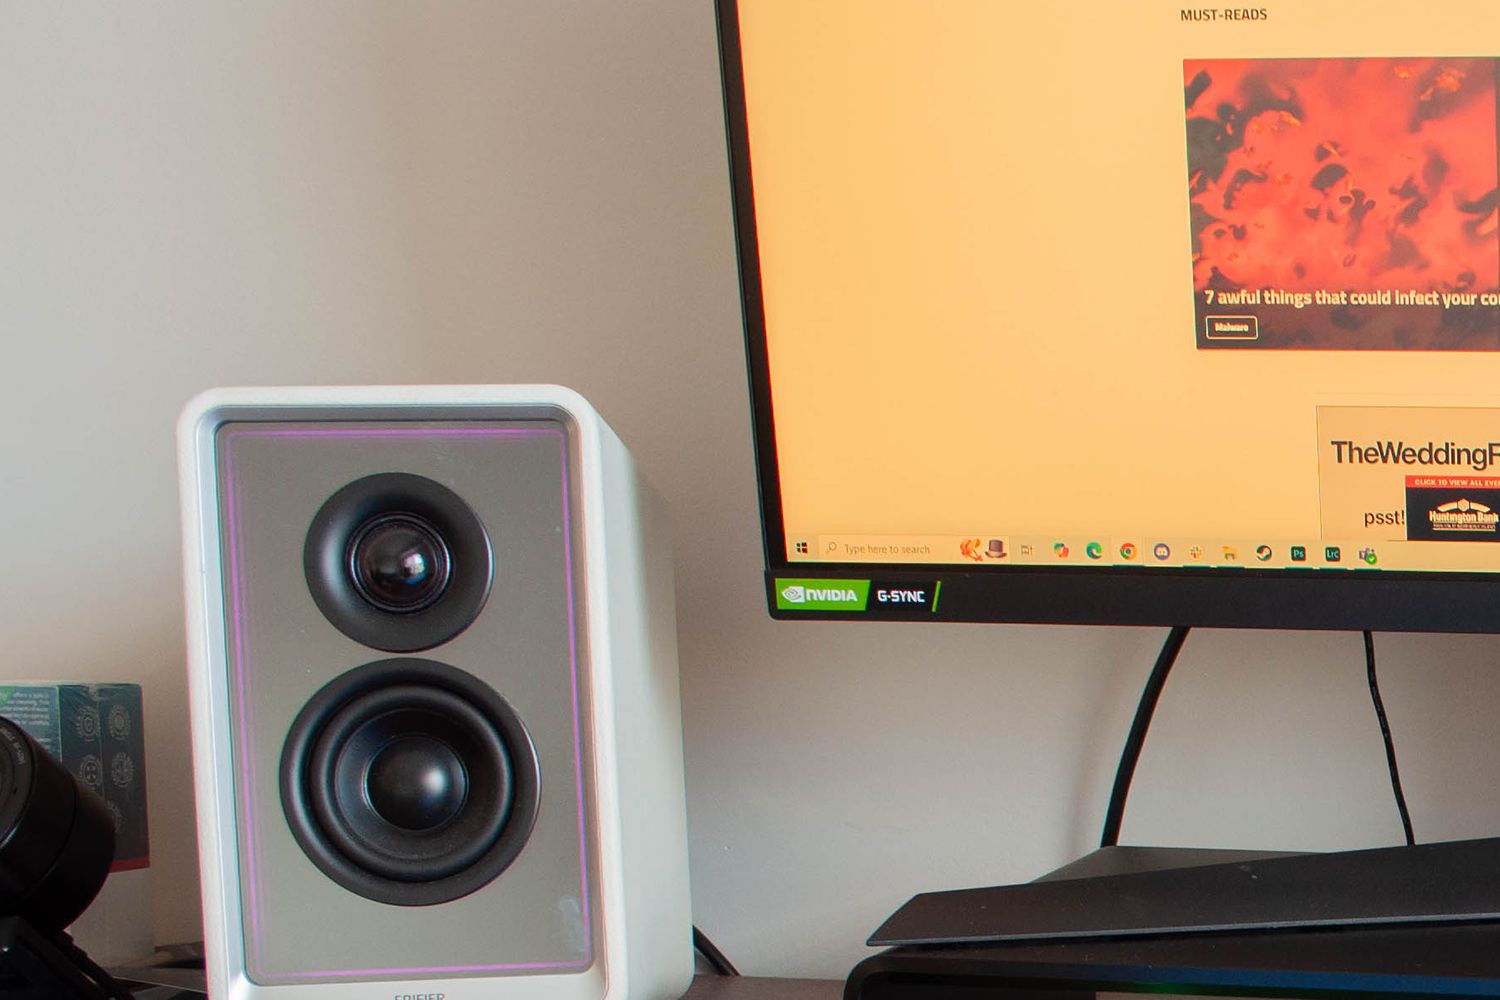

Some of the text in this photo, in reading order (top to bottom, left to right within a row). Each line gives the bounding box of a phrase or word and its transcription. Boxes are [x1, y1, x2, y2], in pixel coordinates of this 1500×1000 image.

[1180, 9, 1267, 21] MUST-READS
[1205, 290, 1214, 304] 7
[1217, 290, 1260, 306] awful
[1263, 290, 1312, 308] things
[1315, 291, 1348, 306] that
[1351, 290, 1392, 306] could
[1395, 290, 1440, 306] infect
[1443, 293, 1477, 309] your
[1214, 322, 1249, 333] Malware
[1364, 510, 1405, 528] psst!
[1429, 511, 1499, 524] Huntington Bank
[845, 544, 930, 555] Type here to search
[1294, 550, 1304, 558] Ps
